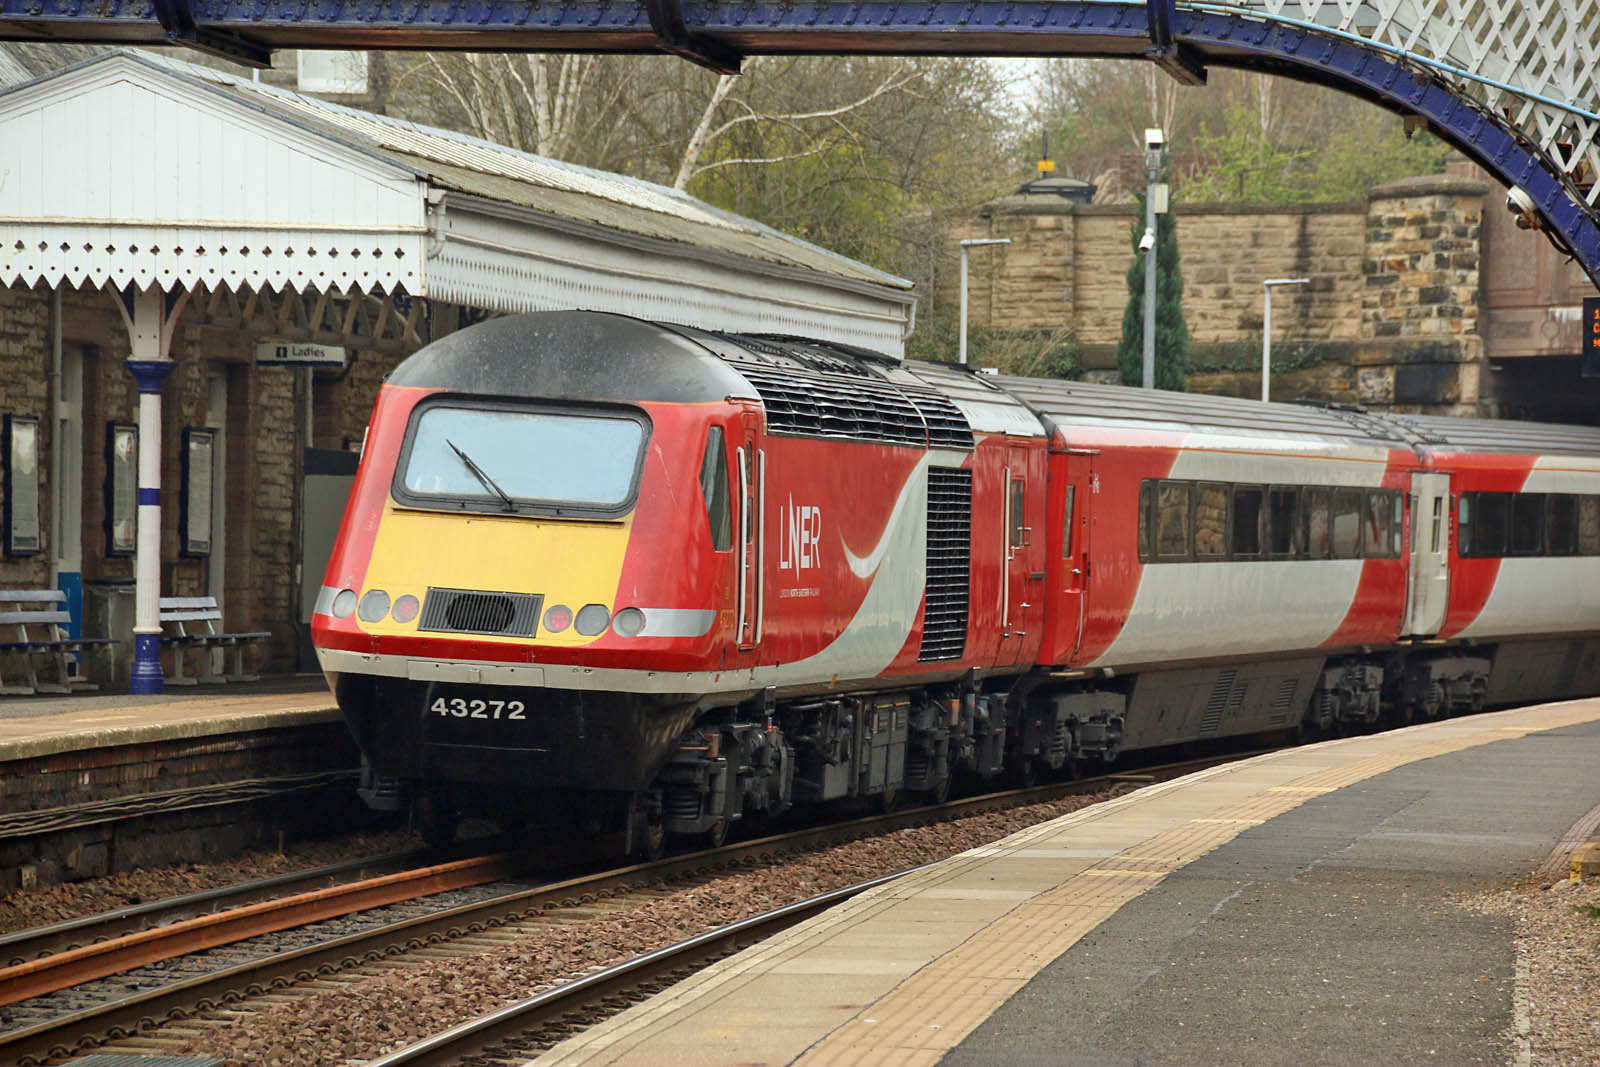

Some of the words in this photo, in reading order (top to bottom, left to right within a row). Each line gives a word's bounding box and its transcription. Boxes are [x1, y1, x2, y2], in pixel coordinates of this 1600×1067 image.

[292, 345, 326, 357] Ladies
[779, 491, 821, 582] LNER
[430, 697, 526, 720] 43272
